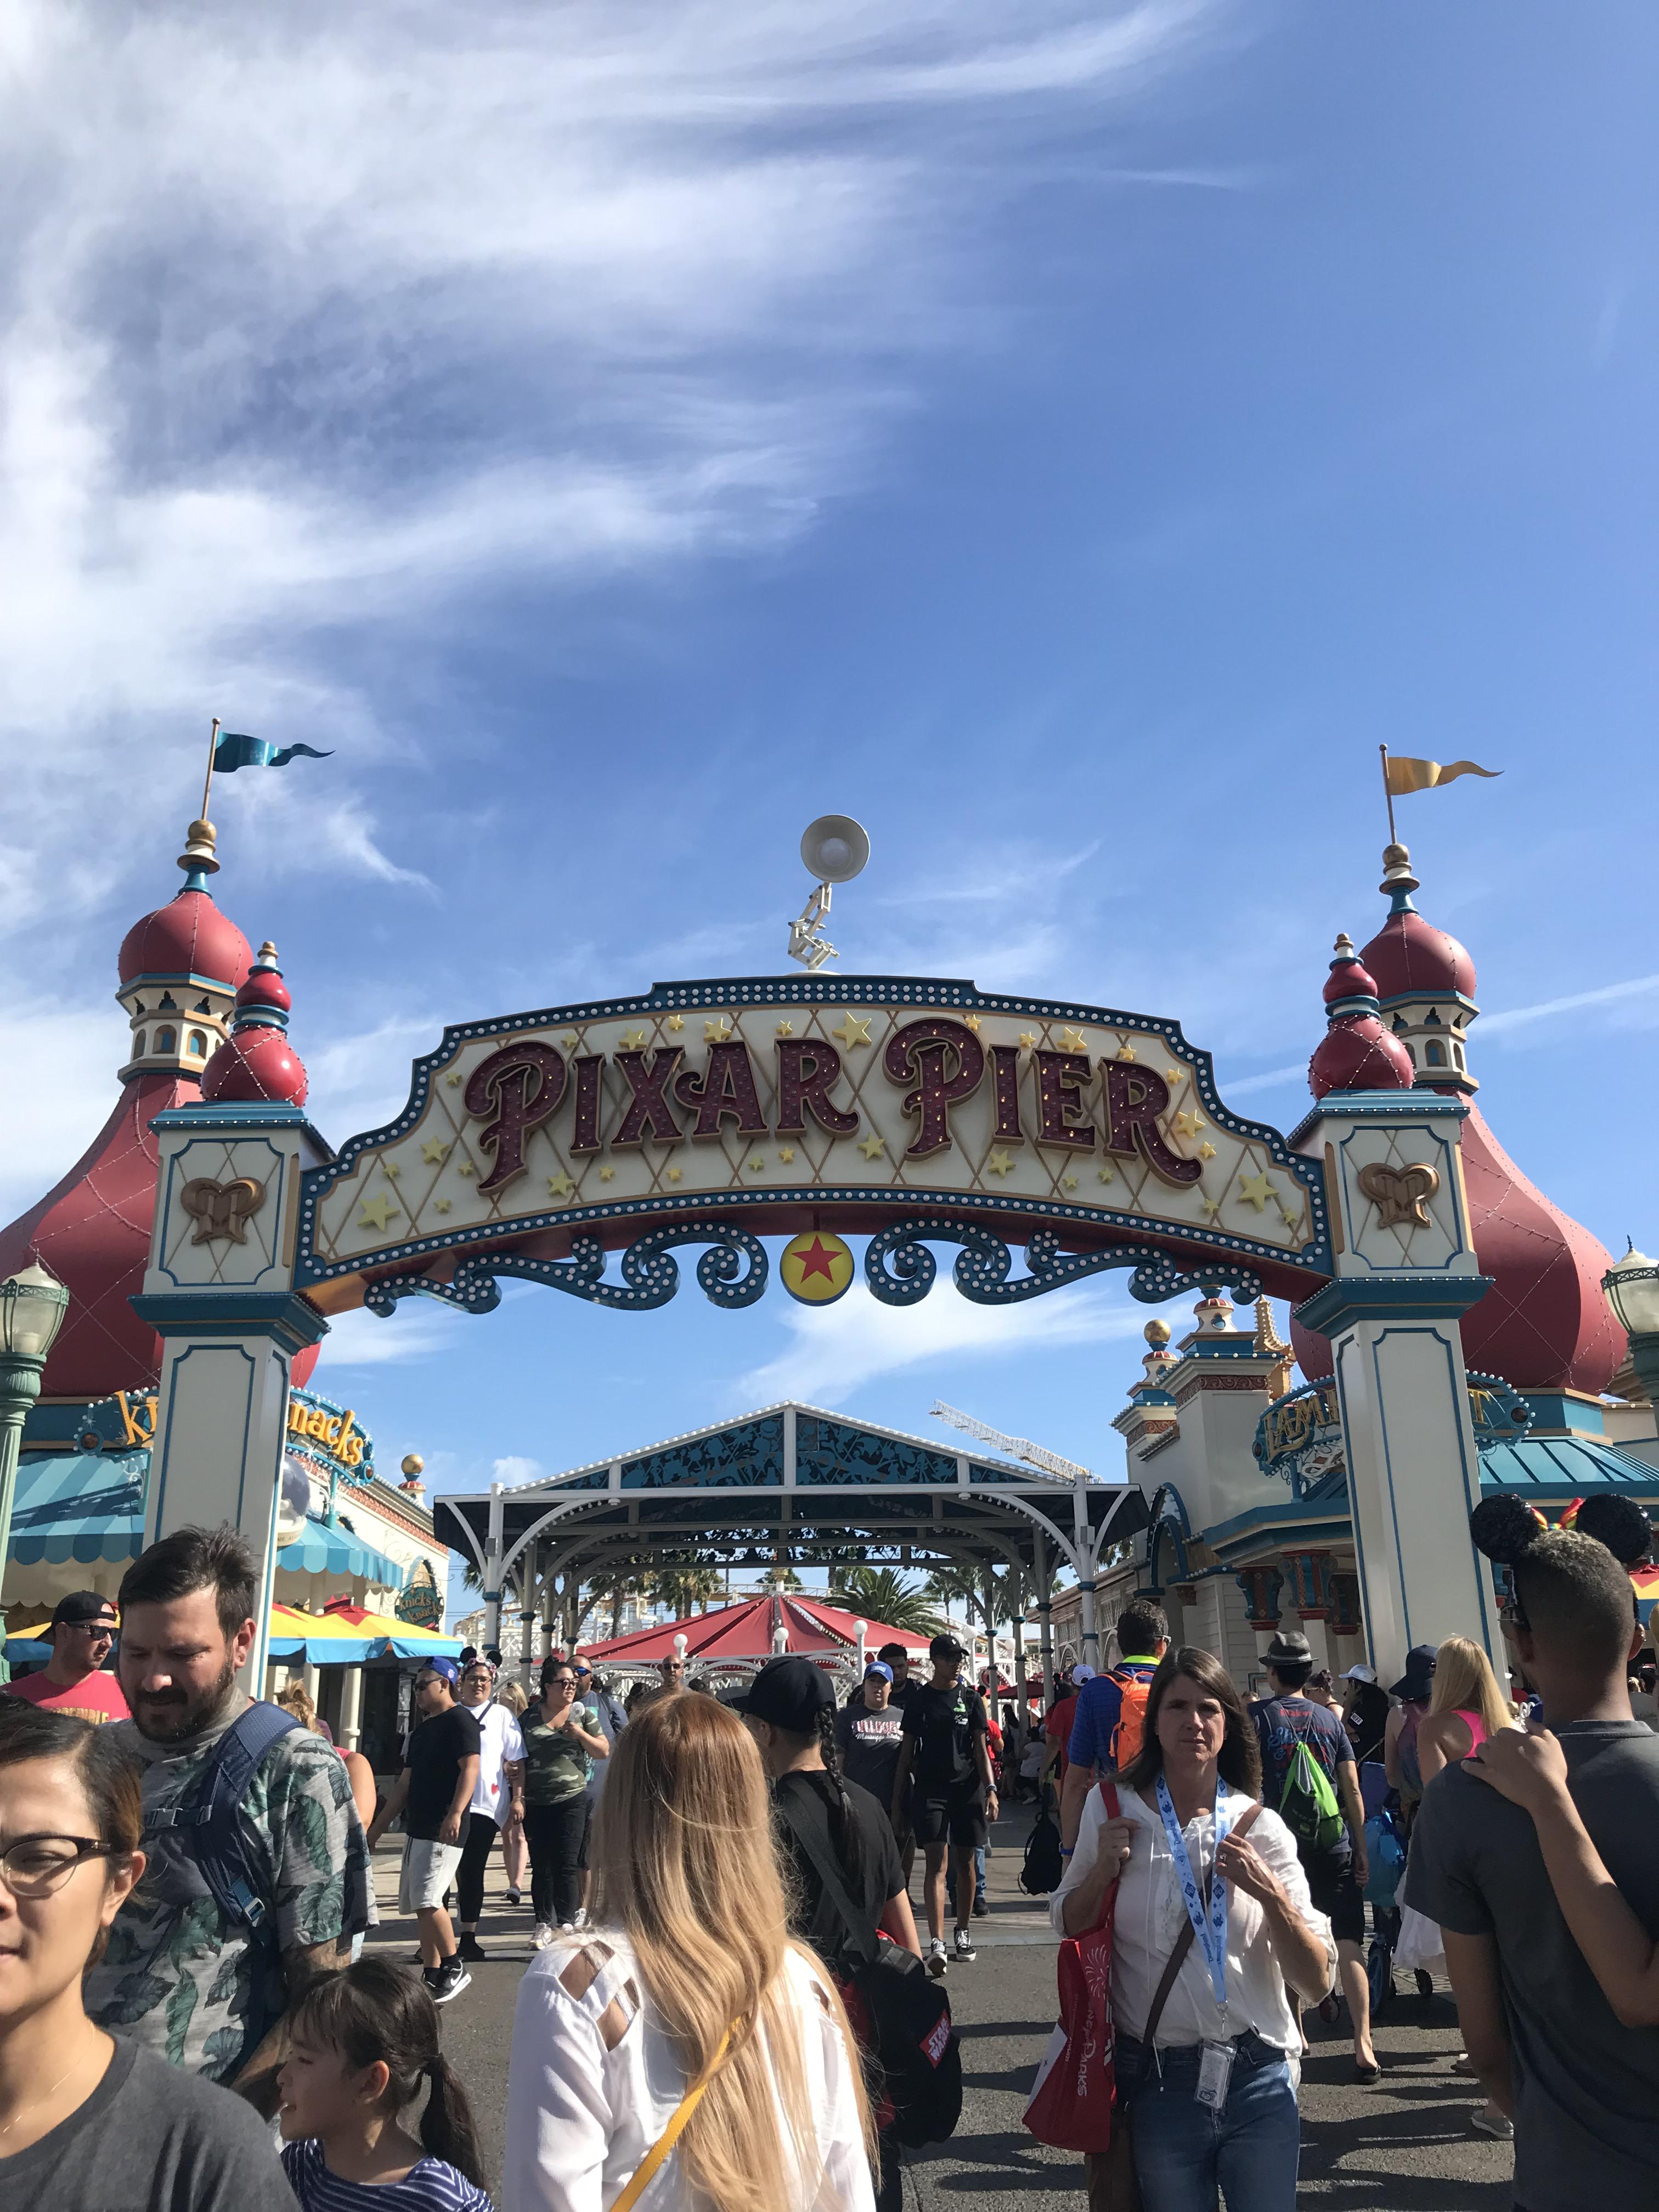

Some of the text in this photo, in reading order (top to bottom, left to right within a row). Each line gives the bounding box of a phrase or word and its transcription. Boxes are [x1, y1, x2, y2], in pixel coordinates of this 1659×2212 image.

[464, 1017, 1204, 1197] PIXAR PIER
[287, 1403, 364, 1466] nacks
